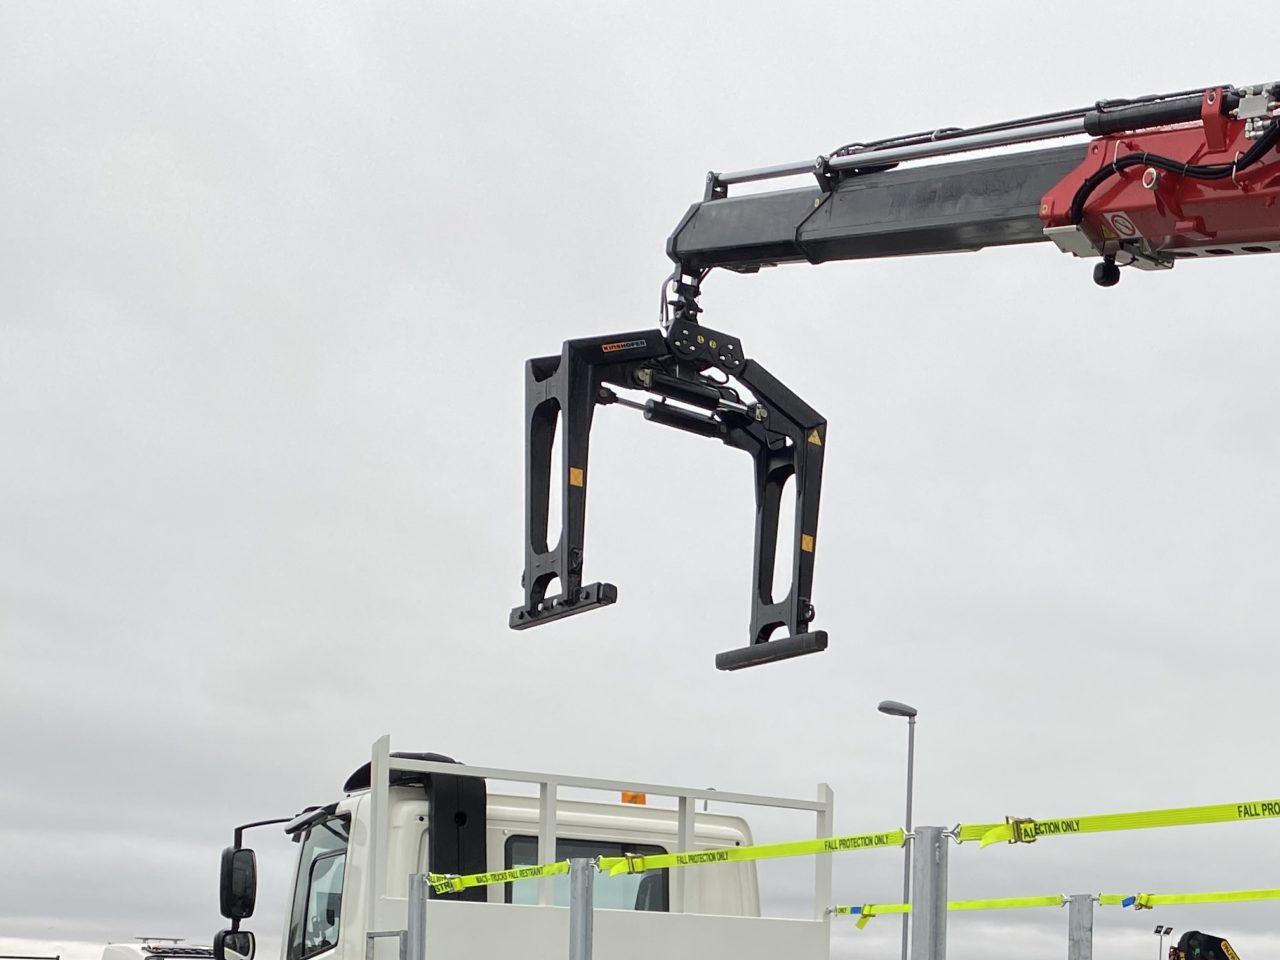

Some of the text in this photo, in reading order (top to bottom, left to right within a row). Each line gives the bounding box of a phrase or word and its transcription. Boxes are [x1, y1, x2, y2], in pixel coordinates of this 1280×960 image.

[1237, 804, 1260, 818] FALL
[1034, 819, 1080, 835] ECTION ONLY
[824, 835, 889, 850] FALL PROTECTION ONLY
[676, 850, 729, 865] FALL PROTECTION ONLY
